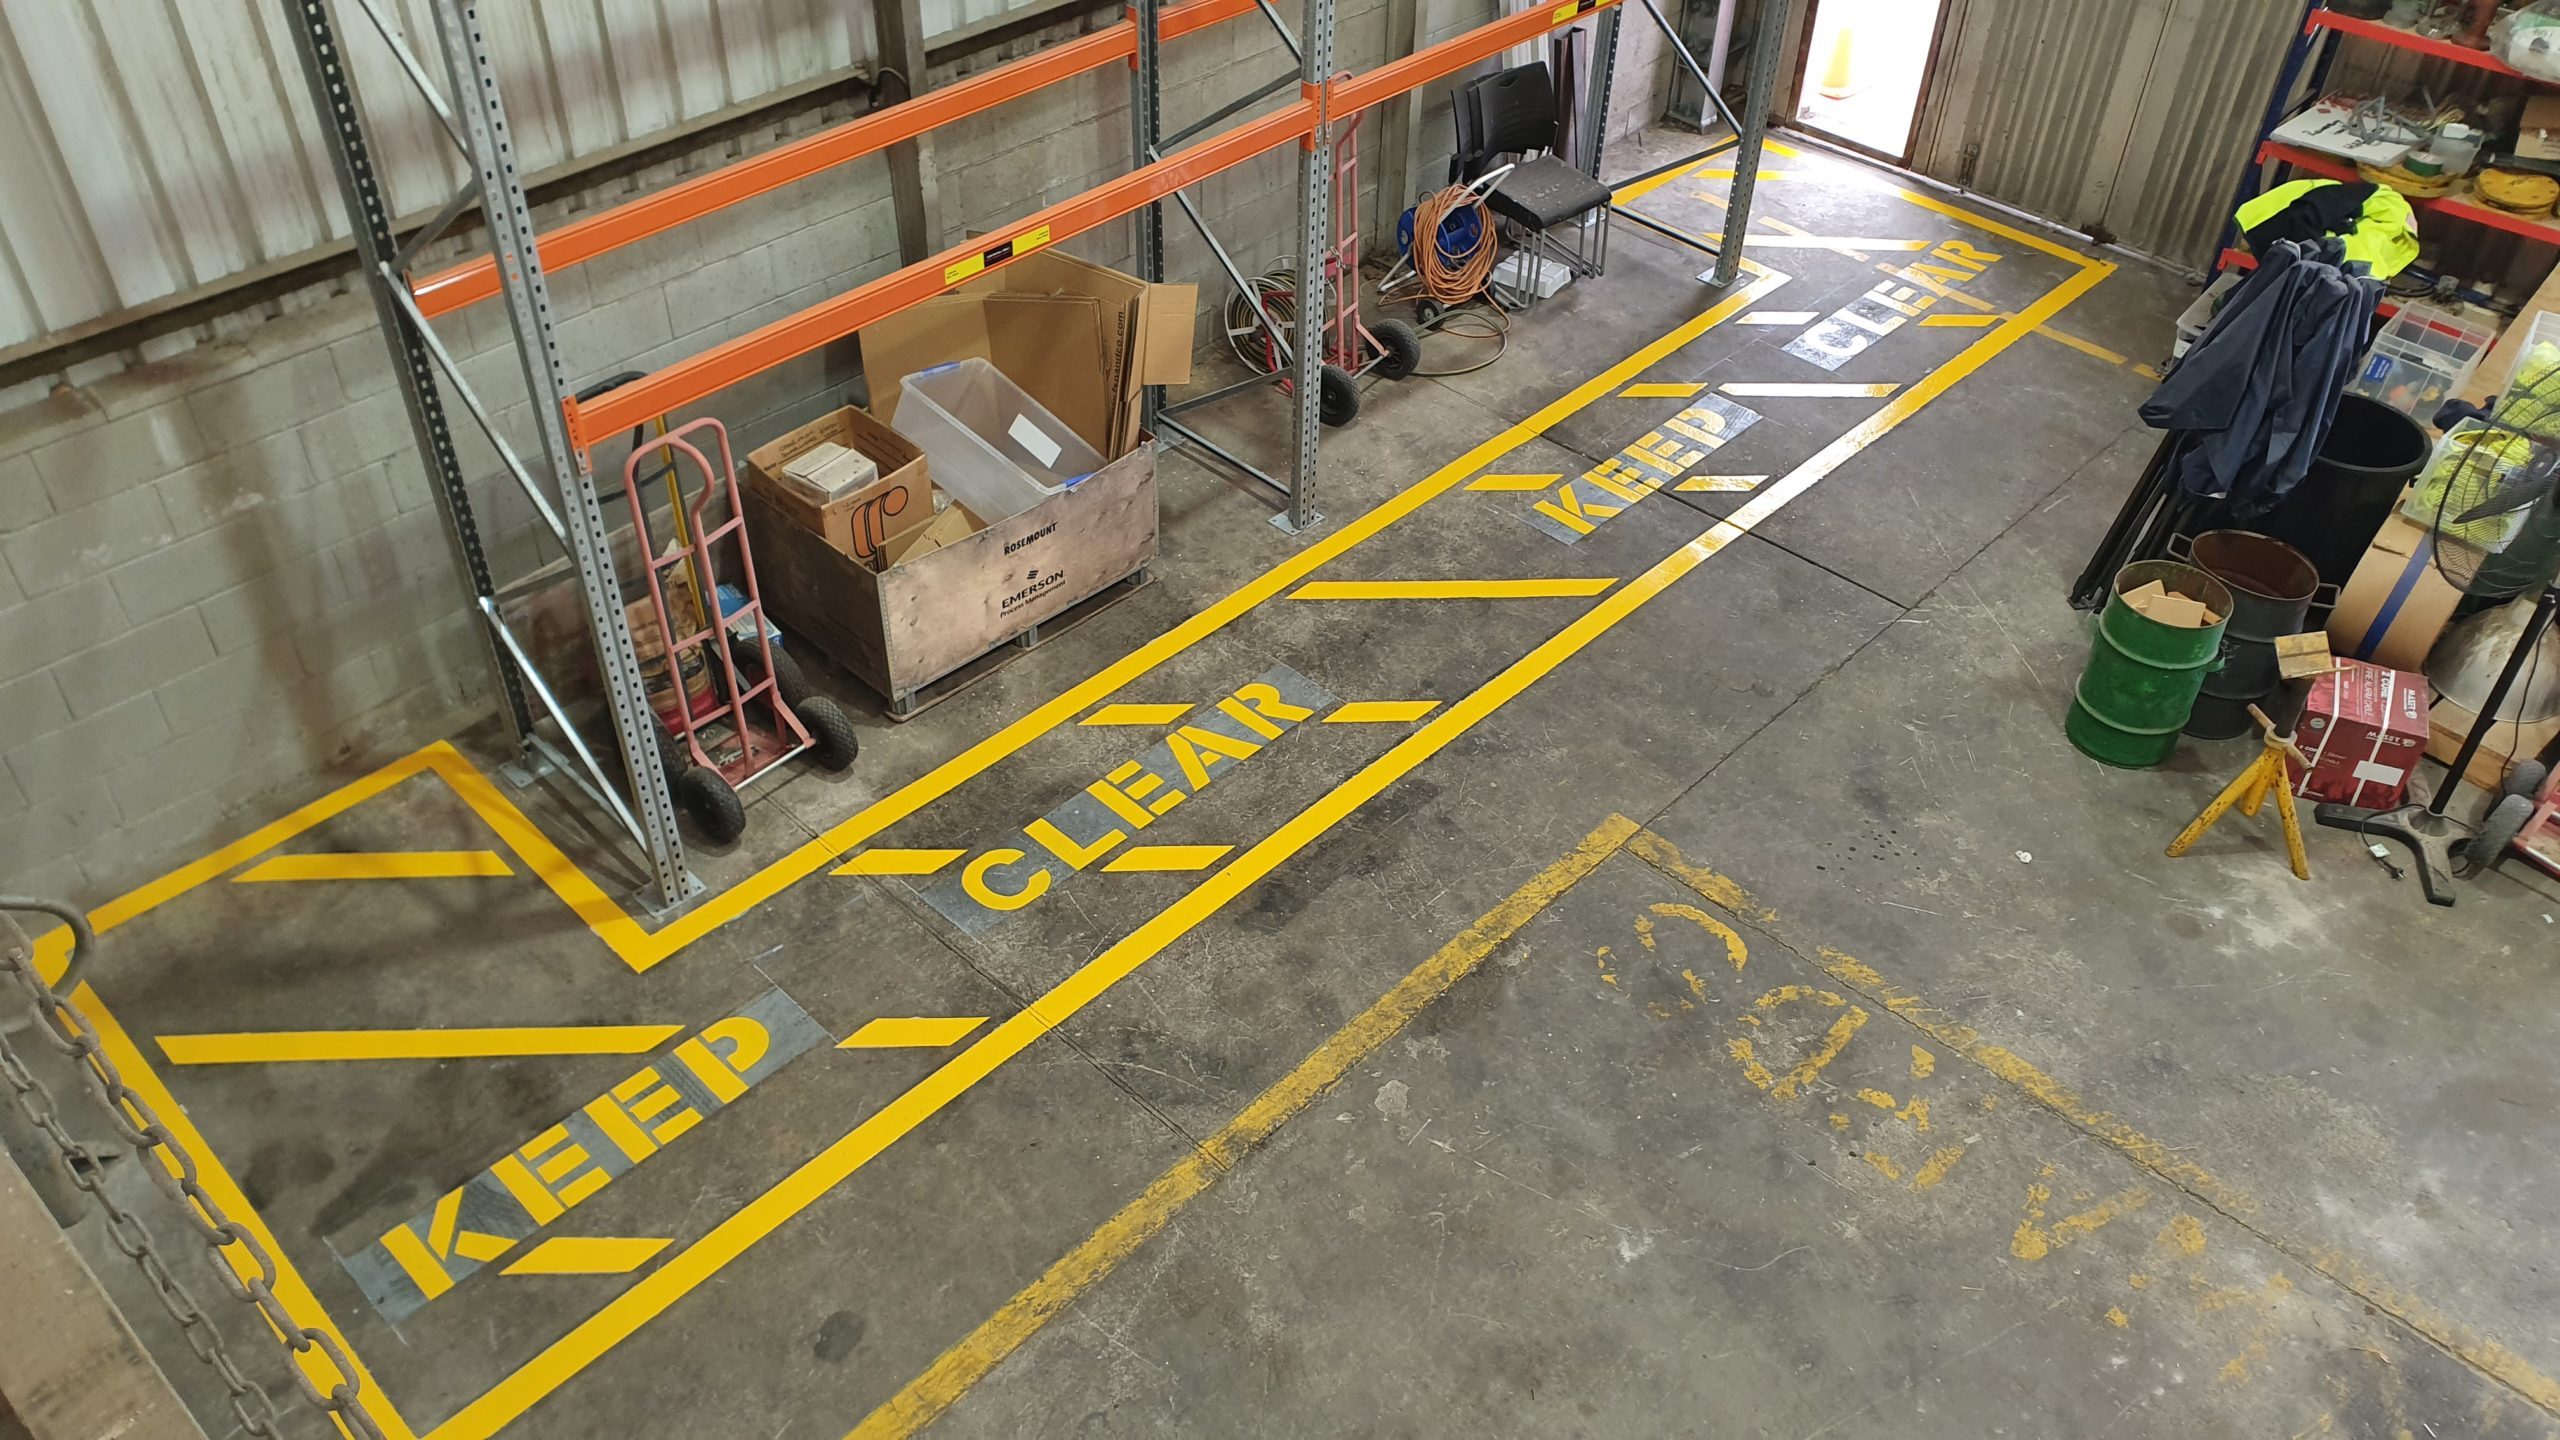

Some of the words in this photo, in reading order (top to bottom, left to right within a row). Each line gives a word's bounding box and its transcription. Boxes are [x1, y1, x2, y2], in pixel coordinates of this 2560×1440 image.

[1532, 408, 1726, 535] KEEP
[1805, 240, 2003, 356] CLEAR
[1004, 522, 1058, 555] ROSEMOUNT
[1000, 602, 1024, 618] Process
[1025, 579, 1066, 605] Management
[1002, 570, 1064, 609] EMERSON
[379, 1017, 770, 1300] KEEP
[961, 683, 1315, 911] CLEAR
